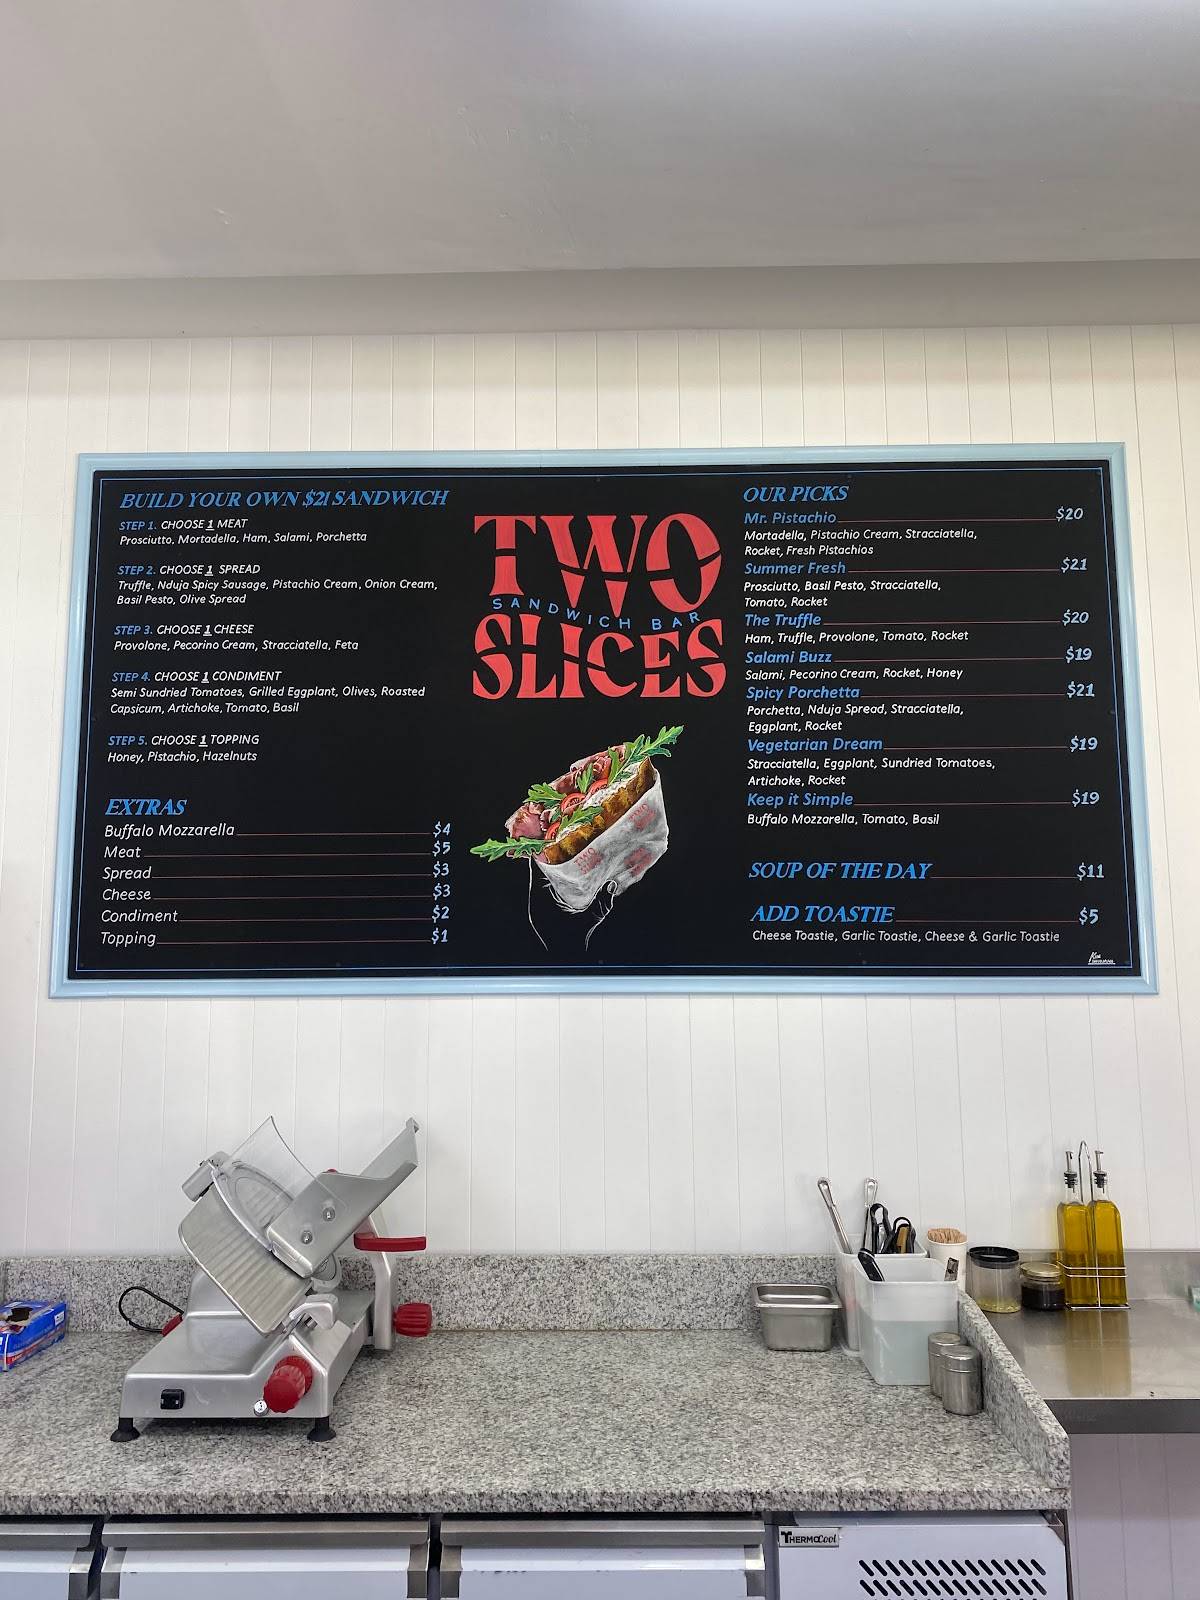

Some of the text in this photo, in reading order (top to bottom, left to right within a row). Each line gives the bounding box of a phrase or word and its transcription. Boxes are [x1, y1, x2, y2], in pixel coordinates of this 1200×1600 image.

[120, 490, 449, 508] BUILD YOUR OWN $21 SANDWICH
[744, 486, 849, 502] OUR PICKS
[744, 507, 1083, 523] Mr. Pistachio $20
[119, 519, 248, 530] STEP 1. CHOOSE 1 MEAT
[178, 534, 239, 544] Mortadella,
[274, 532, 312, 542] Salami,
[316, 532, 367, 541] Porchetta
[745, 529, 976, 541] Mortadella, Pistachio Cream, Stracciatella,
[745, 545, 873, 557] Rocket, Fresh Pistachios
[118, 565, 260, 576] STEP 2. CHOOSE 1 SPREAD
[474, 513, 722, 618] TWO
[745, 557, 1086, 574] Summer Fresh $21
[119, 579, 437, 592] Truffle, Nduja Spicy Sausage, Pistachio Cream, Onion Cream,
[744, 582, 800, 592] Prosciutto,
[805, 581, 831, 590] Basil
[834, 581, 866, 591] Pesto,
[117, 594, 246, 605] Basil Pesto, Olive Spread
[745, 597, 827, 607] Tomato, Rocket
[492, 598, 700, 630] SANDWICH BAR
[745, 610, 1089, 628] The Truffle $20
[114, 624, 254, 636] STEP 3. CHOOSE 1 CHEESE
[745, 631, 968, 644] Ham, Truffle, Provolone, Tomato, Rocket
[114, 640, 358, 651] Provolone, Pecorino Cream, Stracciatella, Feta
[473, 614, 726, 700] SLICES
[746, 646, 1092, 663] Salami Buzz $19
[112, 671, 282, 683] STEP 4. CHOOSE 1 CONDIMENT
[746, 668, 963, 680] Salami, Pecorino Cream, Rocket, Honey
[111, 686, 425, 698] Semi Sundried Tomatoes, Grilled Eggplant, Olives, Roasted
[746, 681, 1094, 701] Spicy Porchetta $21
[111, 703, 299, 715] Capsicum, Artichoke, Tomato, Basil
[747, 704, 963, 716] Porchetta, Nduja Spread, Stracciatella,
[749, 721, 842, 734] Eggplant, Rocket
[108, 735, 259, 747] STEP 5. CHOOSE 1 TOPPING
[748, 736, 1097, 754] Vegetarian Dream $19
[108, 751, 257, 763] Honey, Pistachio, Hazelnuts
[747, 758, 995, 770] Stracciatella, Eggplant, Sundried Tomatoes,
[748, 775, 846, 786] Artichoke, Rocket
[748, 789, 1099, 808] Keep it Simple $19
[105, 799, 187, 815] EXTRAS
[748, 813, 939, 826] Buffalo Mozzarella, Tomato, Basil
[105, 822, 450, 839] Buffalo Mozzarella $4
[104, 841, 450, 858] Meat $5
[102, 861, 449, 881] Spread $3
[749, 862, 1104, 880] SOUP OF THE DAY $11
[103, 883, 450, 900] Cheese $3
[102, 905, 449, 923] Condiment $2
[750, 906, 1098, 925] ADD TOASTIE $5
[101, 928, 447, 947] Topping $1
[753, 930, 1059, 942] Cheese Toastie, Garlic Toastie, Cheese & Garlic Toastie
